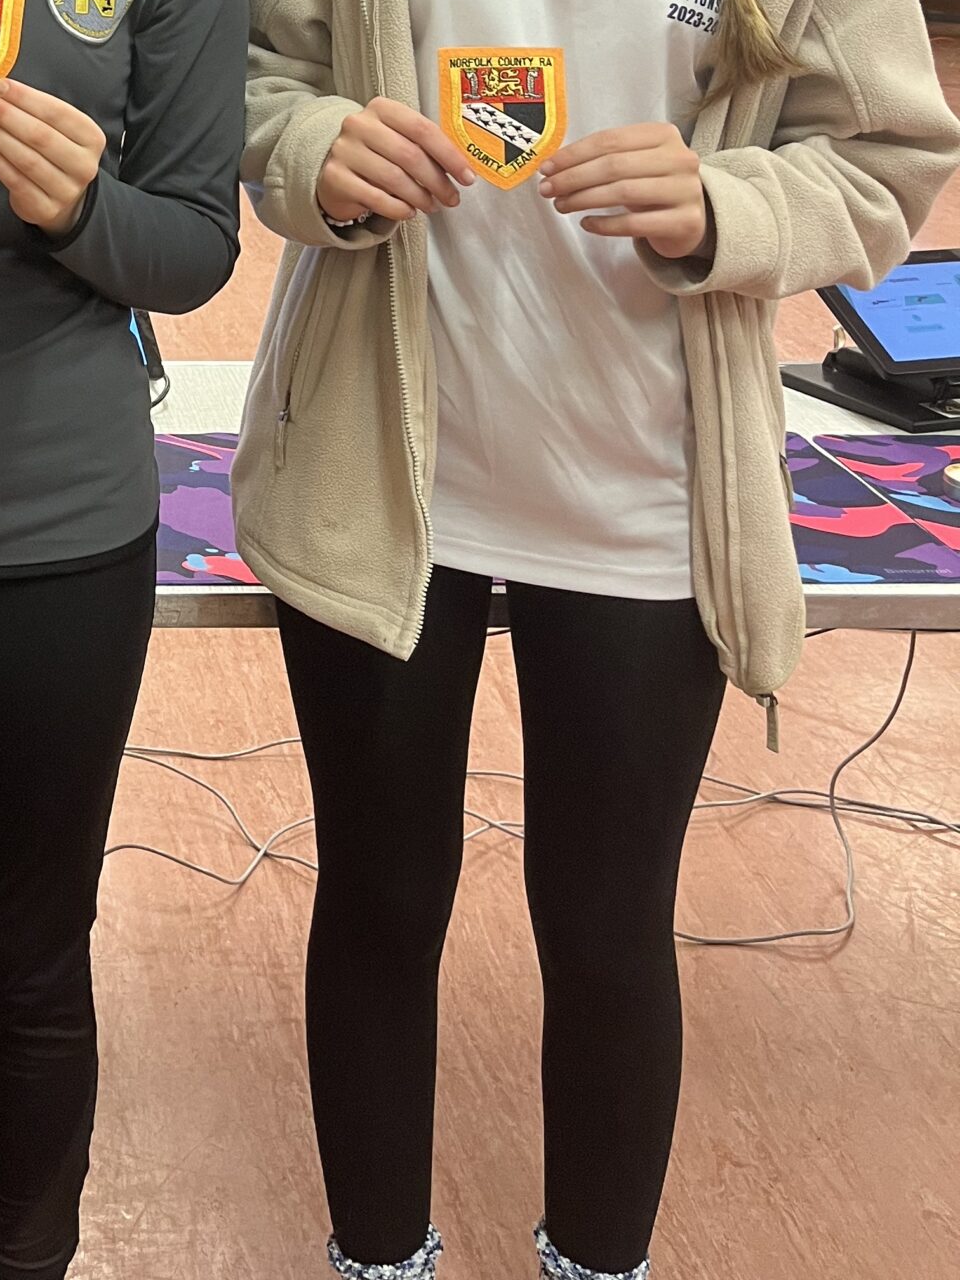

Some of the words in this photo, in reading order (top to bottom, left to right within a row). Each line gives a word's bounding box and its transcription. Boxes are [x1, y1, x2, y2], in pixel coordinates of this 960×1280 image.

[449, 57, 493, 68] NORFOLK
[497, 56, 534, 67] COUNTY
[539, 57, 553, 67] RA
[466, 143, 504, 172] COUNTY
[510, 149, 538, 172] TEAM
